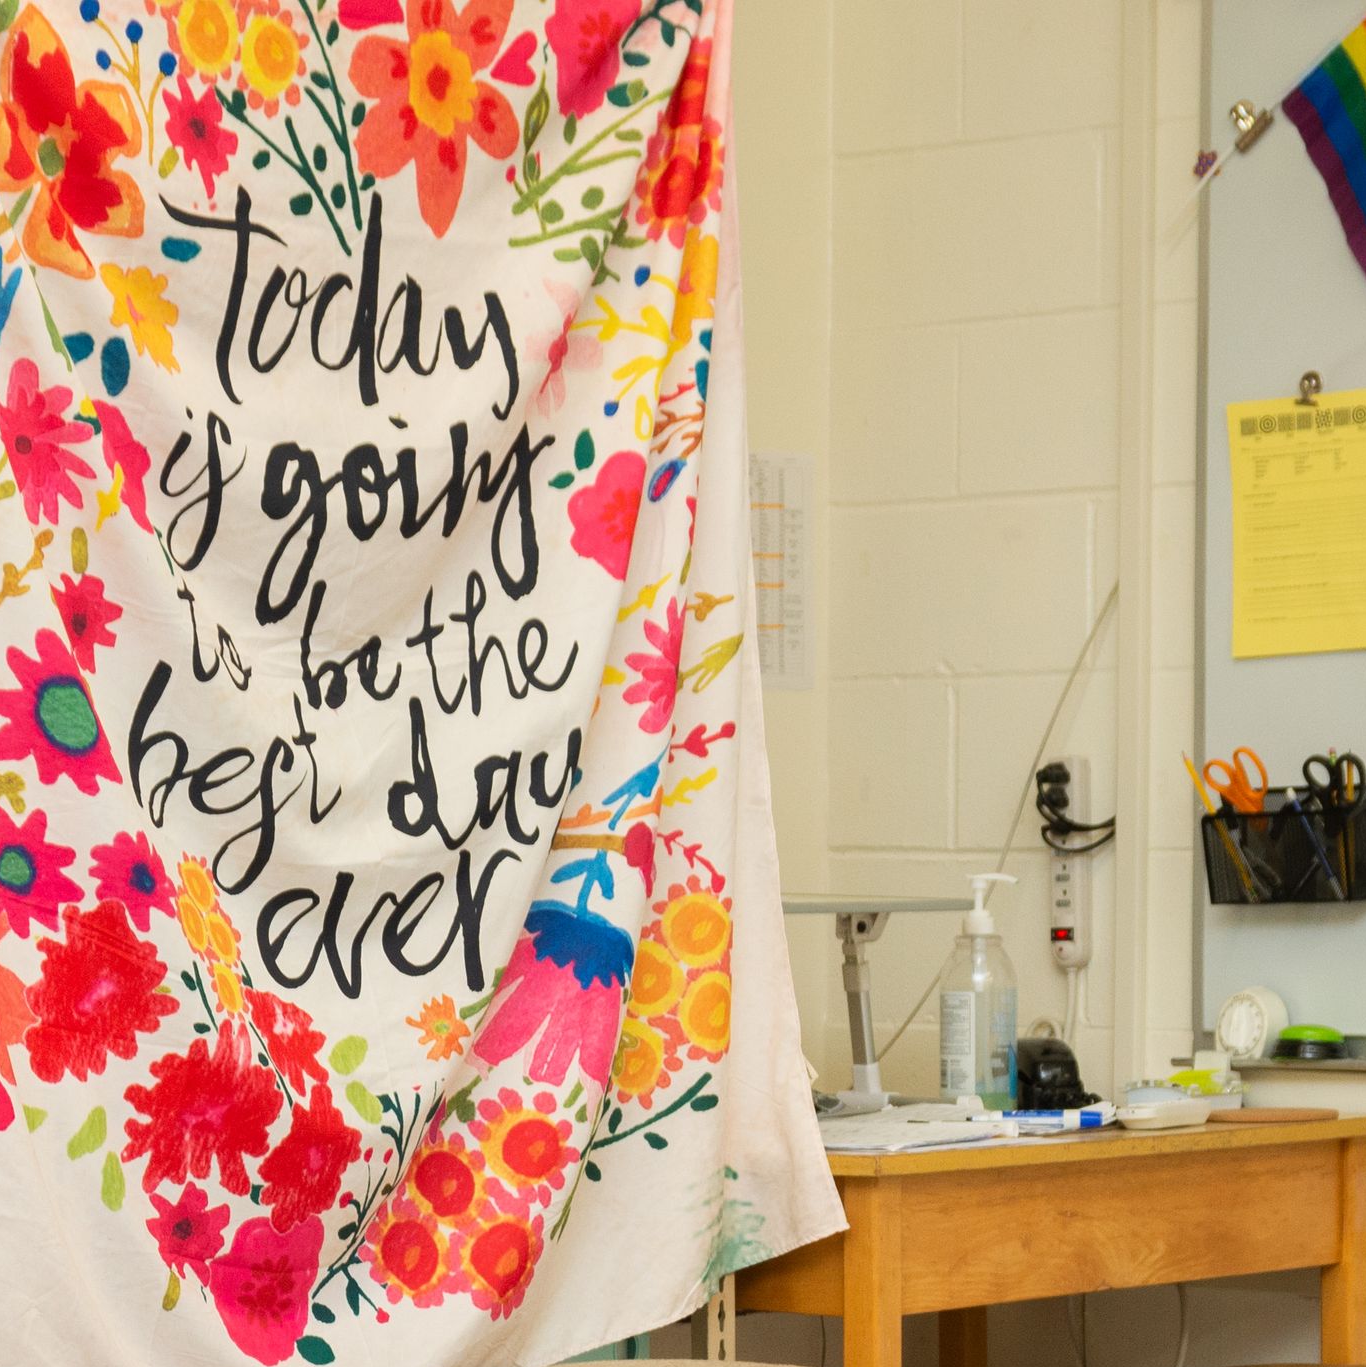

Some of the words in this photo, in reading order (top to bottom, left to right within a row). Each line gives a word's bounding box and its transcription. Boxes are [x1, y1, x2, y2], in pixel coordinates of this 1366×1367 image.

[158, 184, 520, 421] Today
[255, 416, 556, 625] going
[301, 579, 402, 710] be
[406, 569, 580, 717] the
[127, 660, 342, 896] best
[256, 848, 523, 1000] ever
